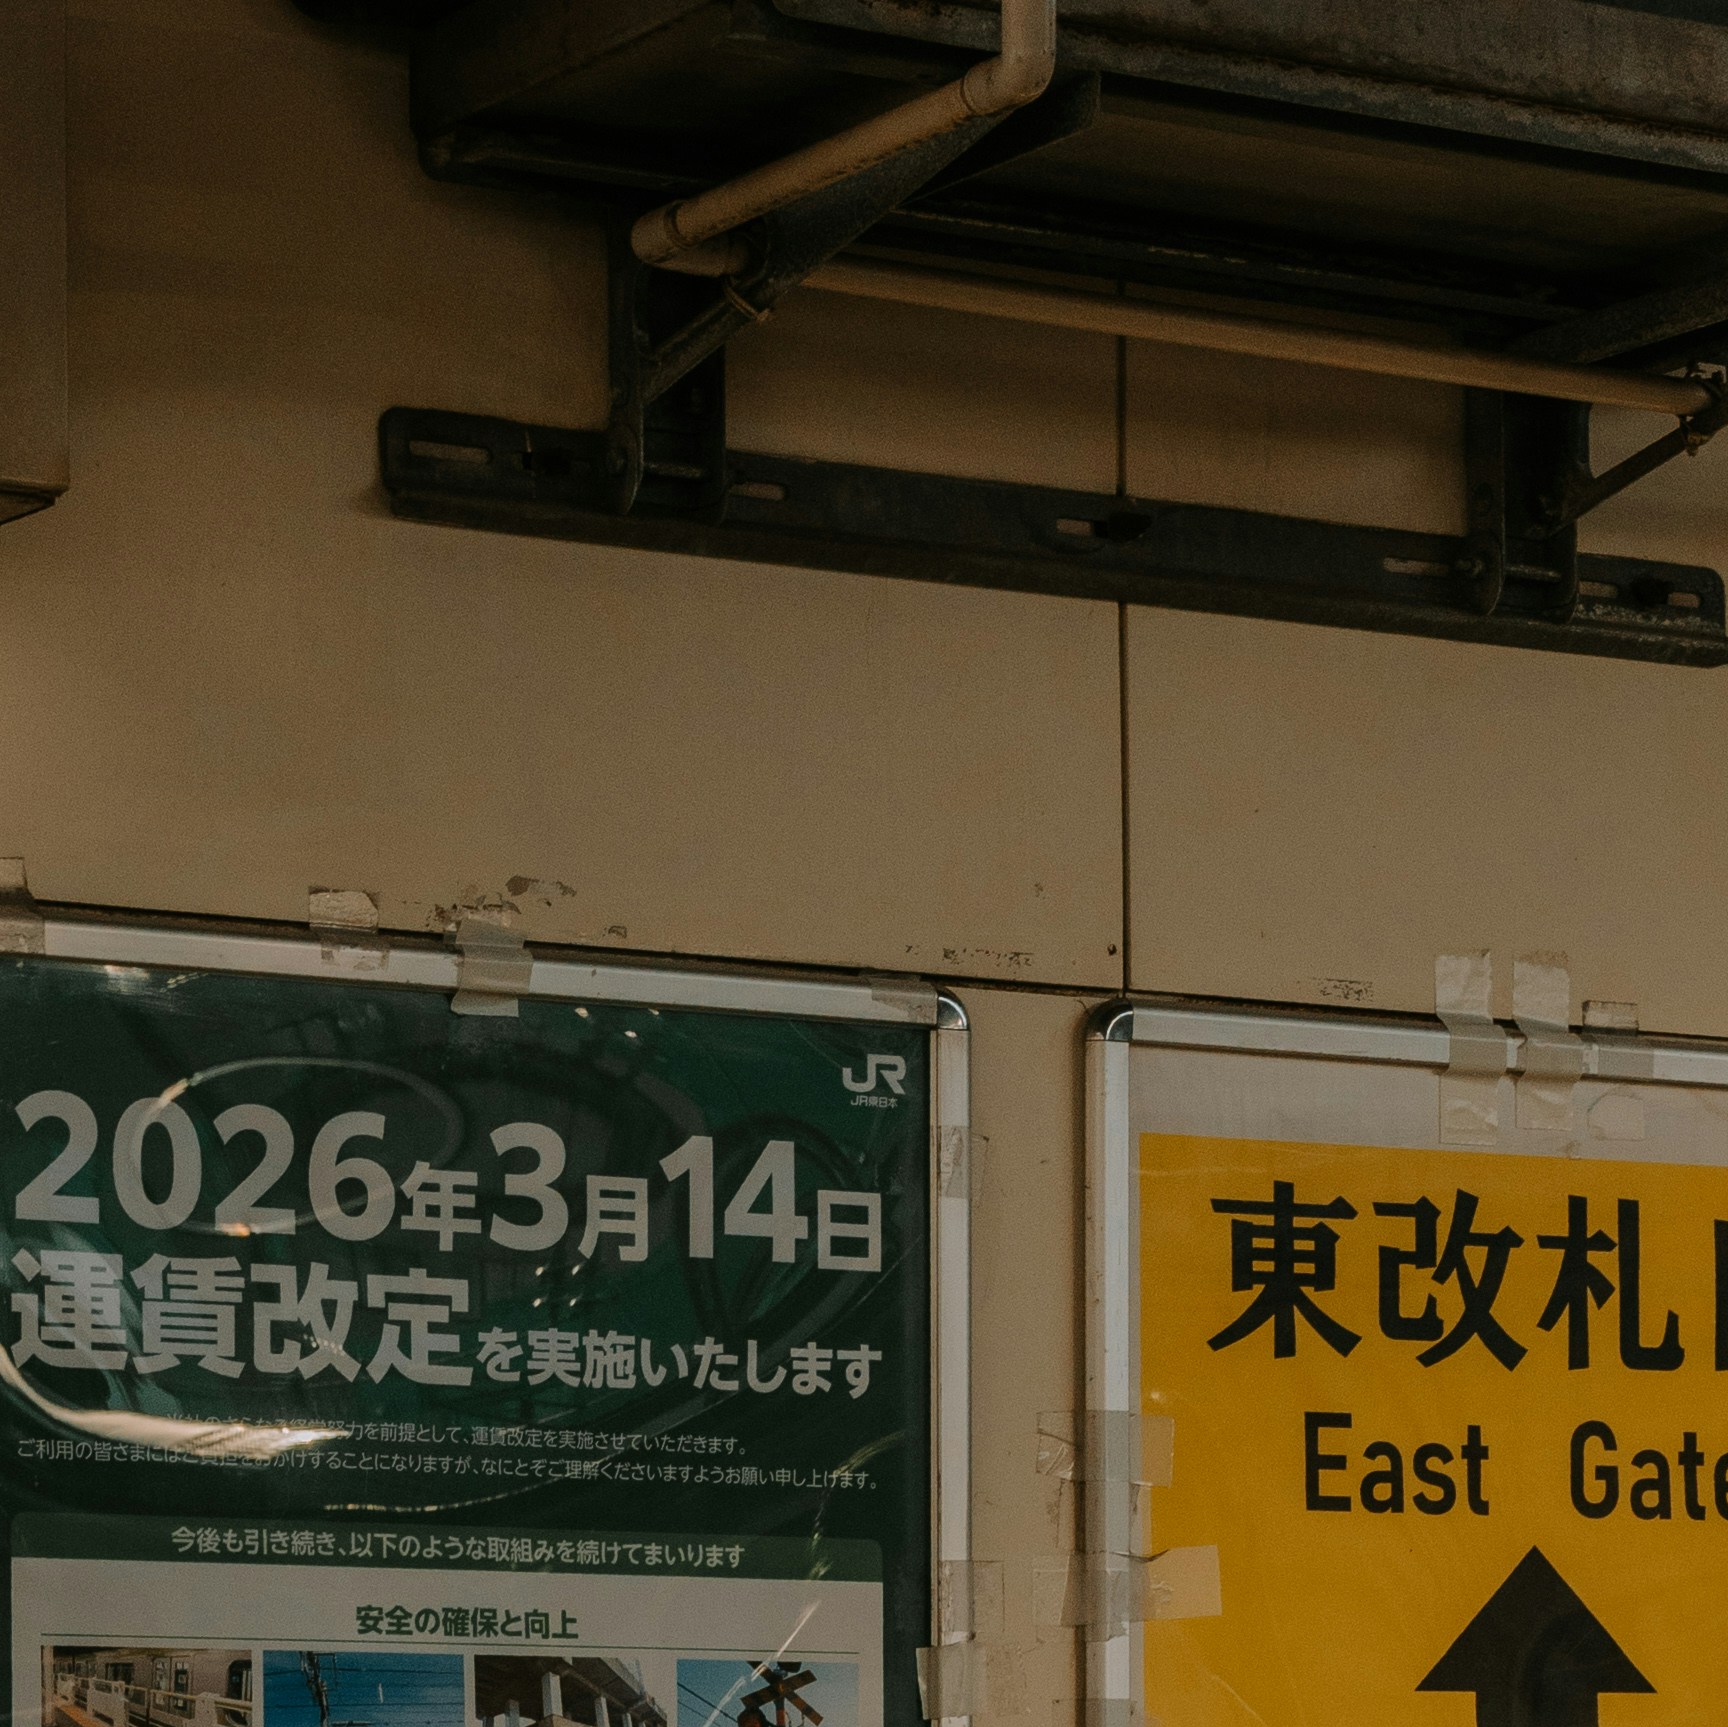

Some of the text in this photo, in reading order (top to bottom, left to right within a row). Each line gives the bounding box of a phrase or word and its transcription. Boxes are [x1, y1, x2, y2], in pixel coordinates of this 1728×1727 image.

[842, 1054, 906, 1095] JR
[850, 1095, 898, 1108] JR東日本
[14, 1089, 883, 1272] 2026年3月14日
[10, 1248, 883, 1399] 運賃改定を実施いたします
[1303, 1411, 1490, 1516] East
[171, 1526, 745, 1568] 今後も引き続き、以下のような取組みを続けてまいります
[356, 1605, 578, 1639] 安全の確保と向上
